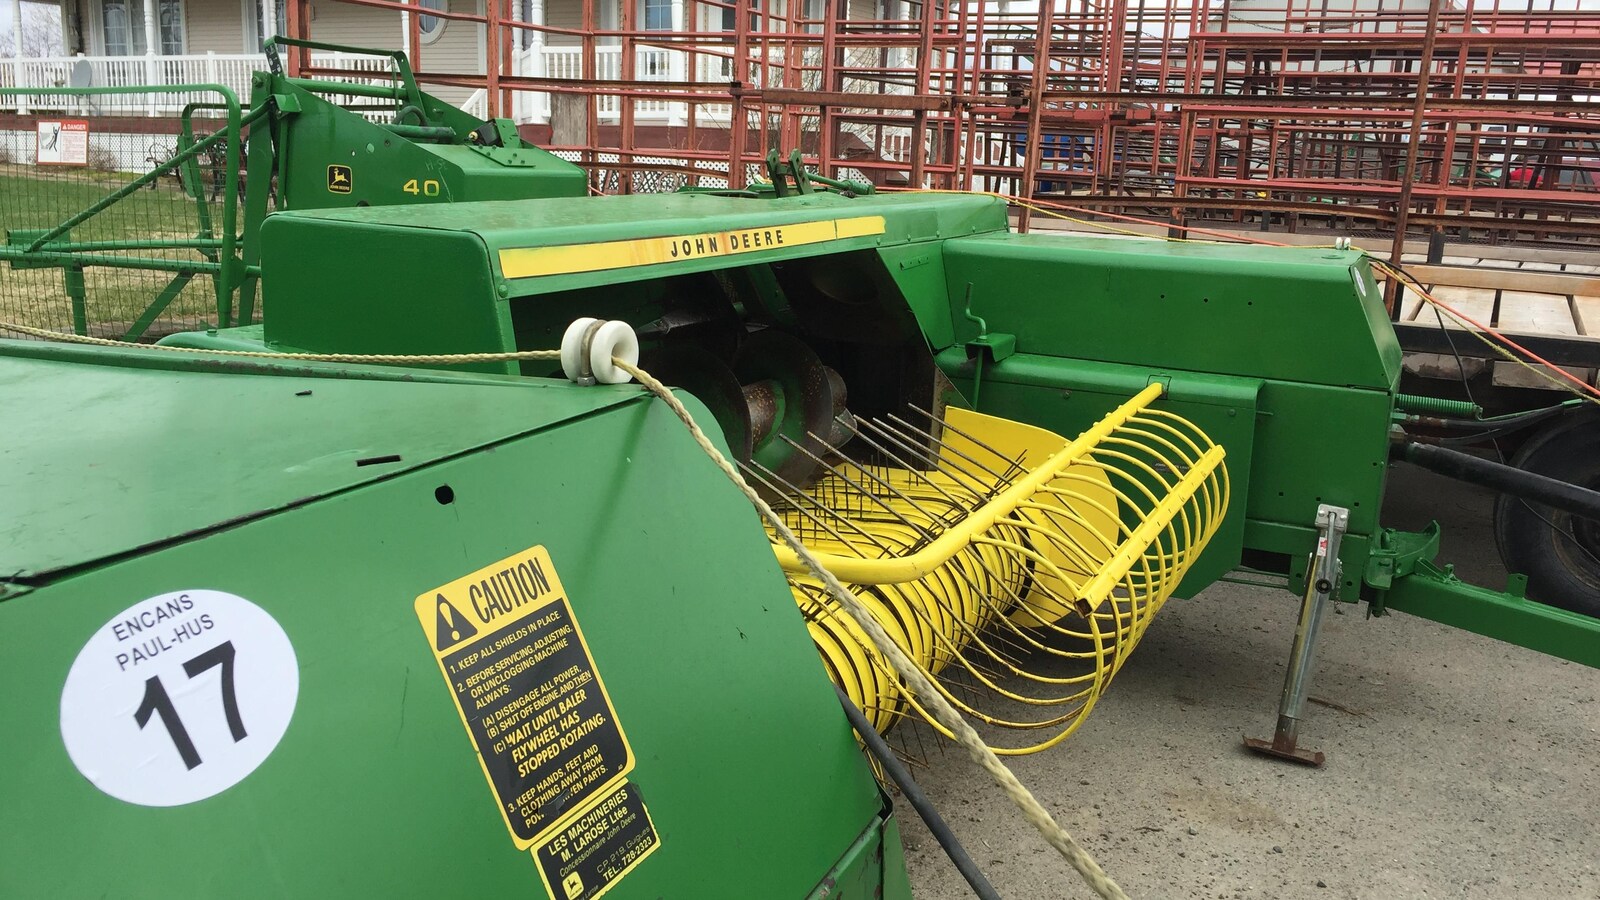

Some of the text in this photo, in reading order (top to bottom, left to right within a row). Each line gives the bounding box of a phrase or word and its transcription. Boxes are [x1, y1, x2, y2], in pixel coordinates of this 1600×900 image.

[403, 179, 440, 197] 40
[671, 230, 783, 257] JOHN DEERE
[112, 594, 194, 642] ENCANS
[469, 557, 551, 624] CAUTION
[115, 613, 214, 671] PAUL-HUS
[450, 611, 562, 674] 1. KEEP ALL SHIELDS IN PLACE.
[470, 637, 568, 698] OR UNCLOGGING MACHINE
[133, 640, 248, 771] 17
[457, 683, 467, 693] 2.
[465, 665, 497, 688] BEFORE
[475, 684, 512, 710] ALWAYS:
[482, 714, 496, 728] (A)
[494, 688, 541, 721] DISENGAGE
[540, 680, 555, 694] ALL
[486, 726, 500, 739] (B)
[499, 712, 521, 732] SHUT
[519, 705, 533, 719] OFF
[559, 680, 576, 695] AND
[574, 670, 592, 688] THEN
[493, 688, 587, 755] (C) WAIT UNTIL BALER
[511, 710, 581, 763] FLYWHEEL HAS
[517, 712, 606, 778] STOPPED ROTATING.
[508, 803, 517, 813] 3.
[516, 787, 536, 807] KEEP
[565, 754, 582, 772] FEET
[583, 744, 599, 758] AND
[520, 754, 604, 818] CLOTHING AWAY FROM
[548, 789, 628, 856] LES MACHINERIES
[559, 812, 637, 877] Concessionnaire John Deere
[560, 806, 628, 862] M. LAROSE Ltée
[621, 836, 652, 866] 728-2323
